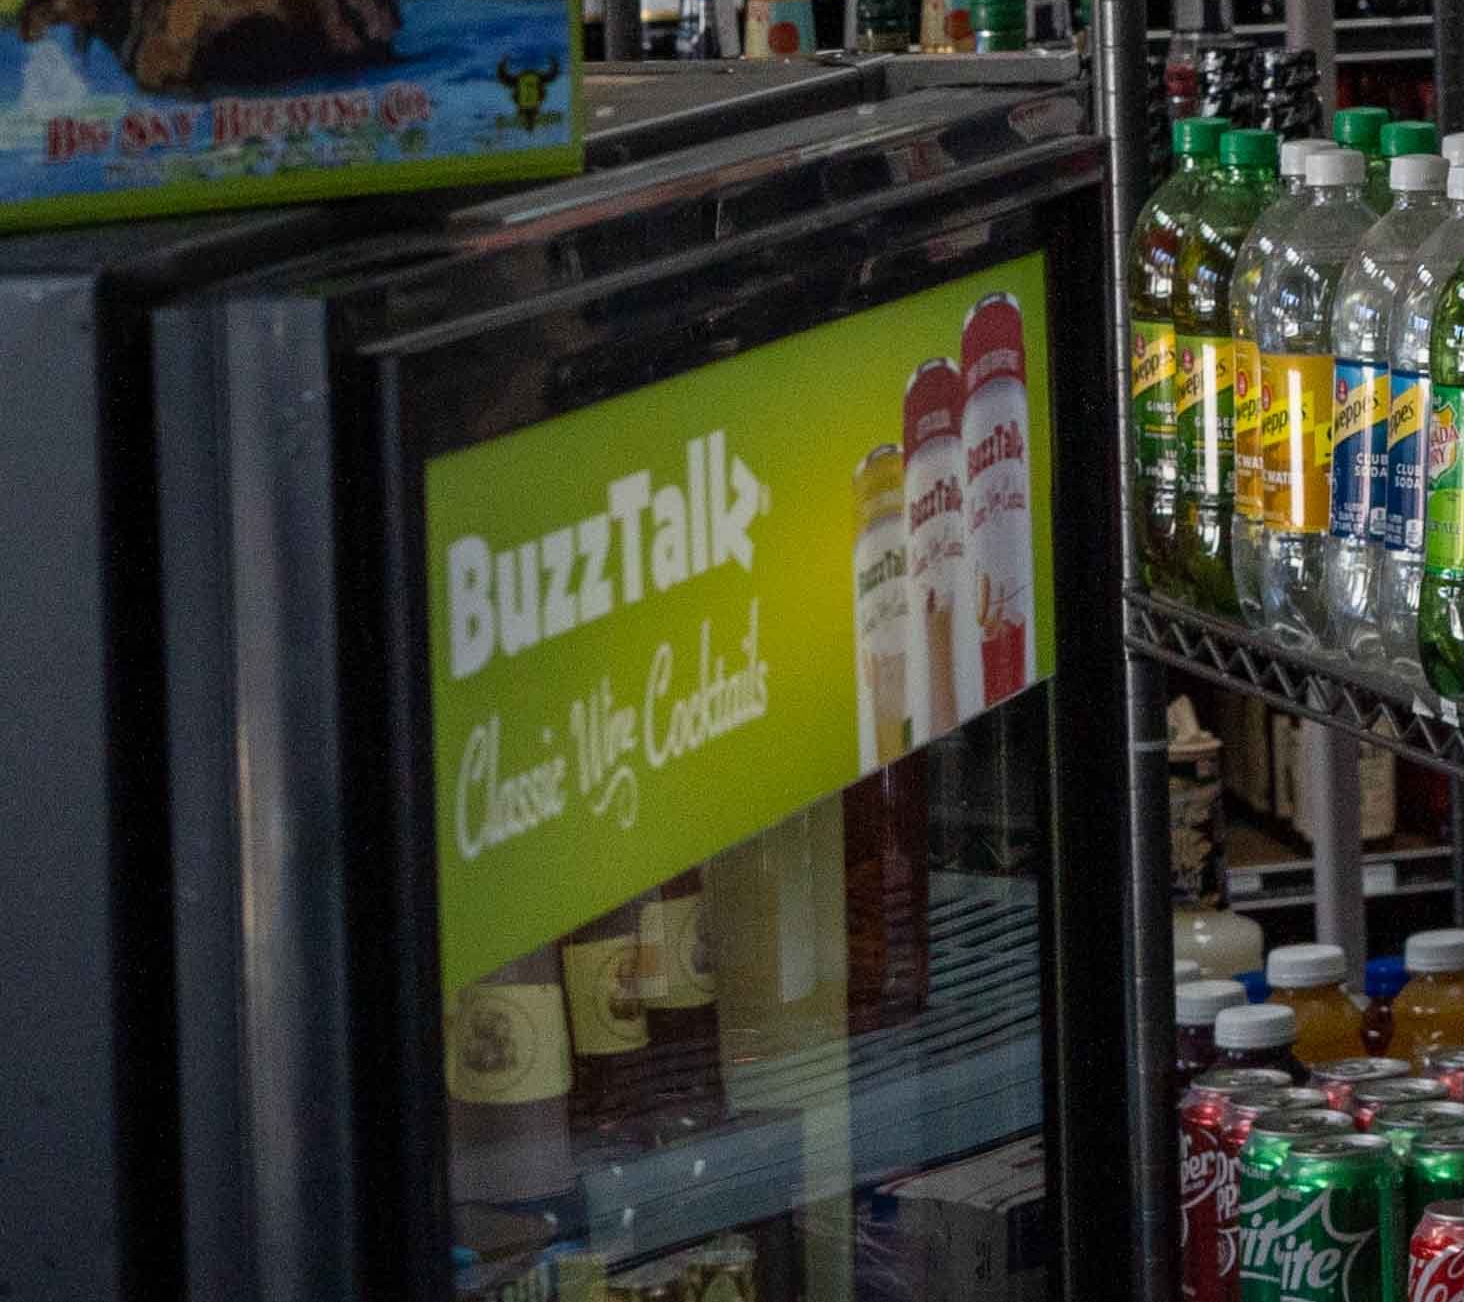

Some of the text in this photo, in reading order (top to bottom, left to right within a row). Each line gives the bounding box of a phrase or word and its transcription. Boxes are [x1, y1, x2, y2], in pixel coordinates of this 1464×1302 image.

[447, 429, 757, 680] BuzzTalk
[455, 717, 566, 860] Classic
[645, 600, 770, 769] Cocktails
